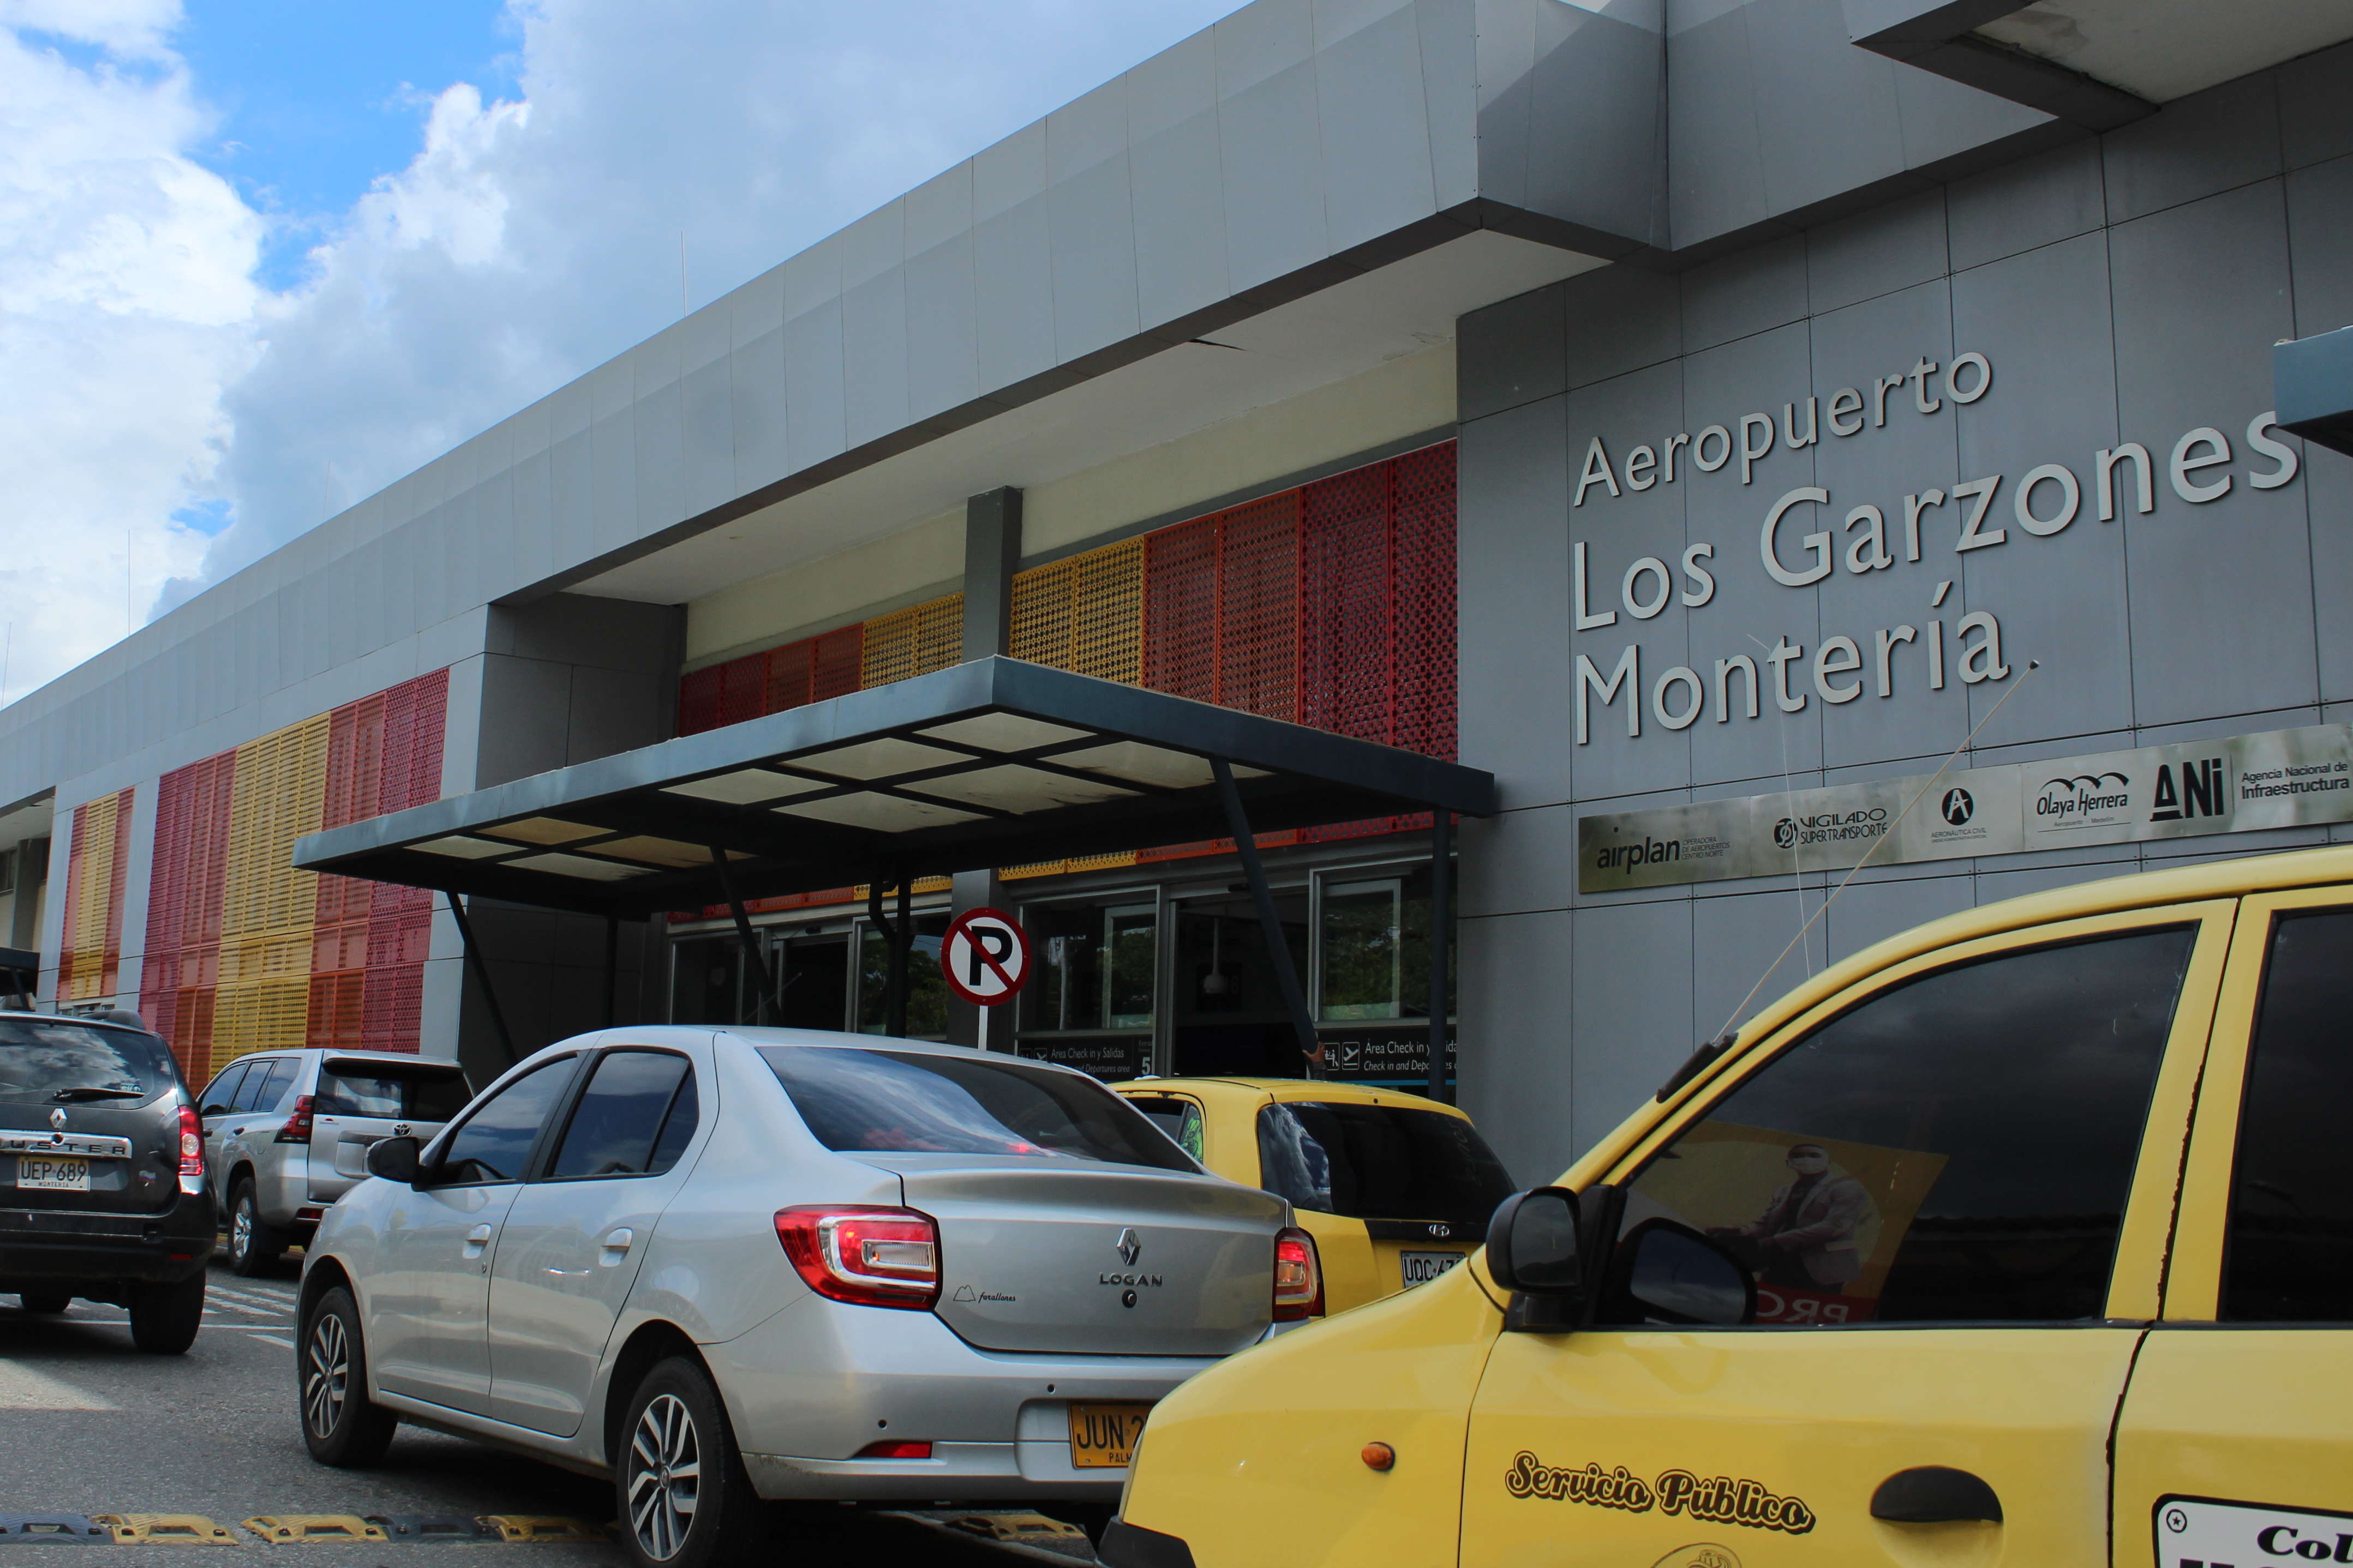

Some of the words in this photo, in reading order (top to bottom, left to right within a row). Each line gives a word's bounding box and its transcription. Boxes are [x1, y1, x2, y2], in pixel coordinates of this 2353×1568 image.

[1574, 352, 1991, 507] Aeropuerto
[1574, 542, 1715, 631] Los
[1760, 410, 2299, 587] Garzones
[1576, 580, 2010, 746] Montería
[2242, 769, 2283, 783] Agencia
[2285, 762, 2331, 778] Nacional
[2334, 761, 2349, 772] de
[2241, 777, 2350, 799] Infraestructura
[2037, 792, 2074, 819] Olaya
[2078, 788, 2128, 816] Herrera
[1800, 808, 1887, 828] VIGILADO
[1683, 836, 1717, 846] OPERADORA
[1800, 822, 1888, 845] SUPERTRANSPORTE
[1597, 826, 1680, 875] airplan
[1681, 851, 1704, 861] CENTRO
[1704, 849, 1724, 858] NORTE
[1690, 841, 1730, 852] AEROPUERTOS
[1051, 1044, 1067, 1059] Área
[1068, 1047, 1087, 1059] Check
[1089, 1047, 1096, 1058] in
[1097, 1049, 1101, 1061] y
[1103, 1046, 1124, 1058] Salidas
[1365, 1038, 1385, 1054] Área
[1387, 1041, 1414, 1054] Check
[1416, 1041, 1424, 1053] in
[1085, 1064, 1116, 1075] Departures
[1141, 1056, 1151, 1076] 5
[1364, 1060, 1385, 1071] Check
[1387, 1061, 1394, 1071] in
[1396, 1060, 1410, 1071] and
[0, 1140, 125, 1155] USTER
[1098, 1271, 1163, 1287] LOGAN
[978, 1291, 1016, 1304] farallones
[1505, 1451, 1655, 1513] Servicio
[1655, 1469, 1816, 1535] Público
